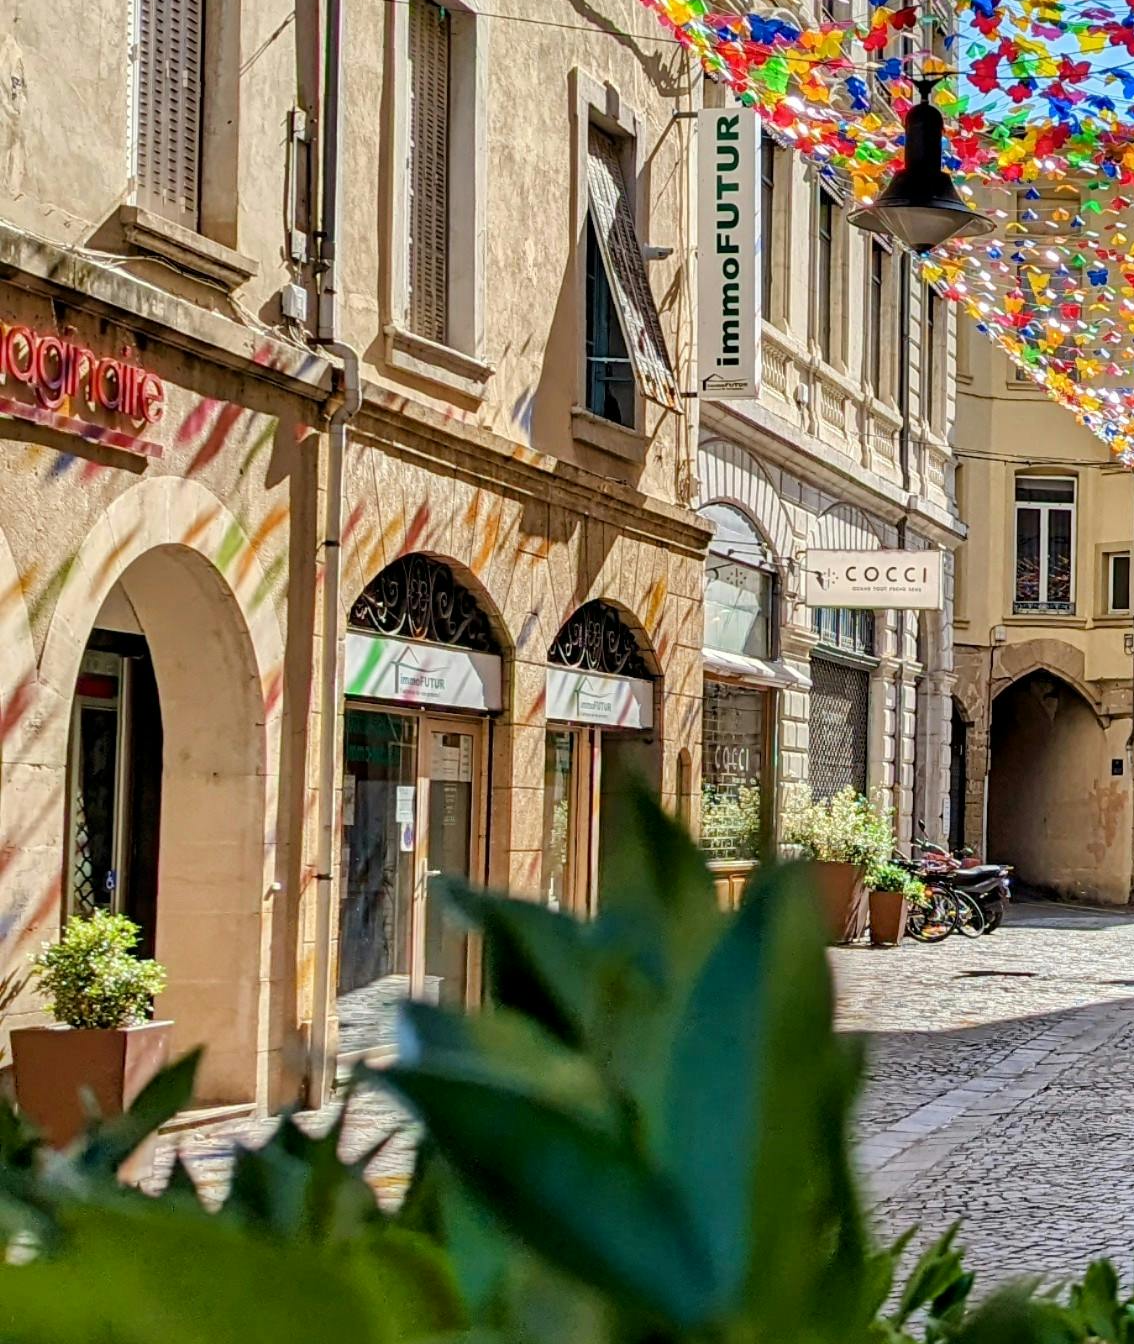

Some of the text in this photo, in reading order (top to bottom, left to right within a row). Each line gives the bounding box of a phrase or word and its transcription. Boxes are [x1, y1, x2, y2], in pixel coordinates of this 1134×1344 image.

[716, 114, 740, 367] immoFUTUR
[0, 321, 164, 424] aginaire
[845, 566, 927, 583] COCCI
[400, 672, 445, 690] immoFUTUR
